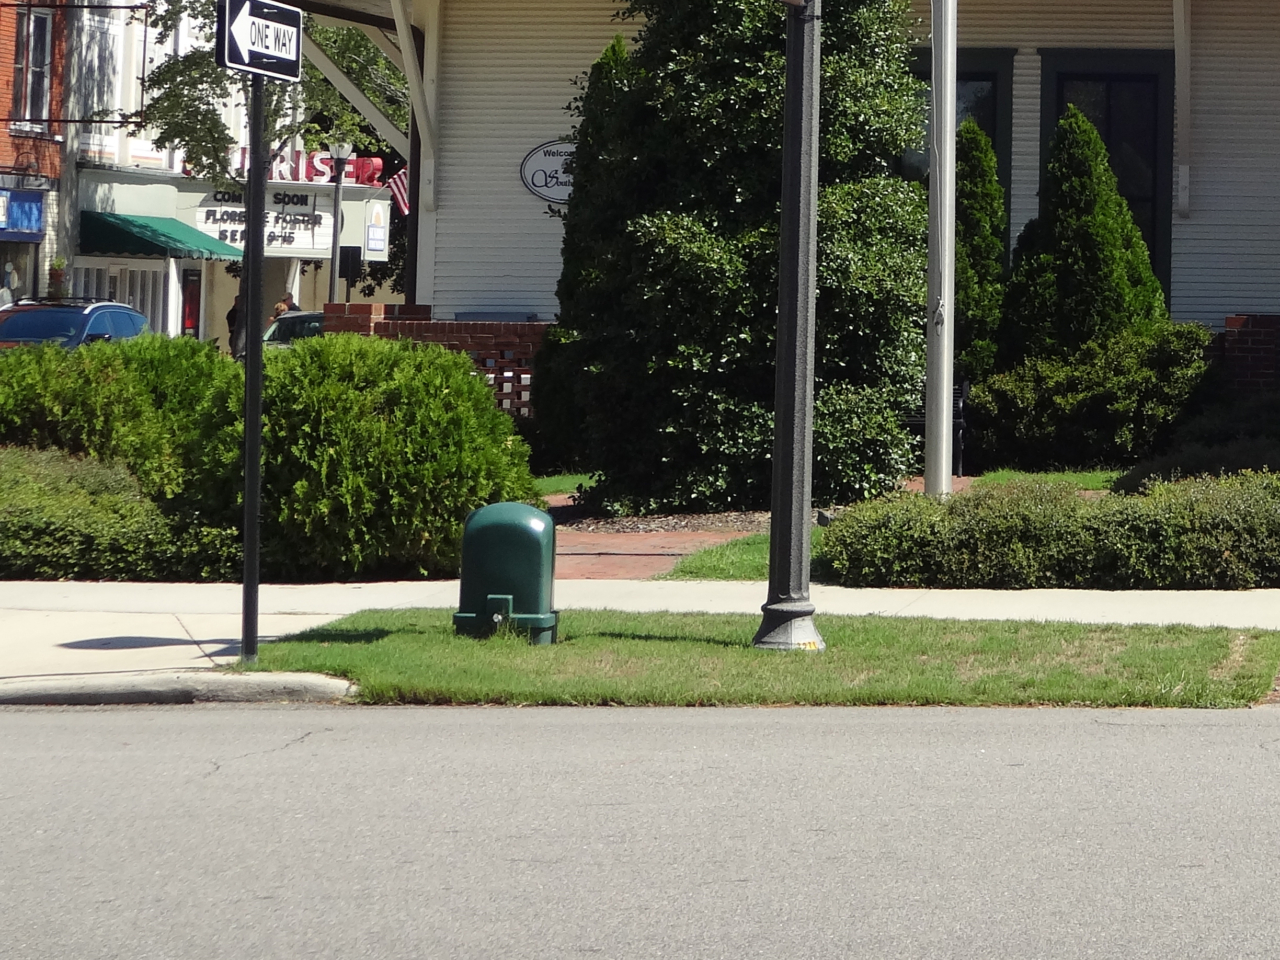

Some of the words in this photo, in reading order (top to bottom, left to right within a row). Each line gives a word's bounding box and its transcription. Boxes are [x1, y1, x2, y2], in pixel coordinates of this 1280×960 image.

[250, 20, 270, 50] ONE
[273, 26, 294, 55] WAY
[273, 192, 308, 206] SOON
[275, 212, 323, 226] FOSTER
